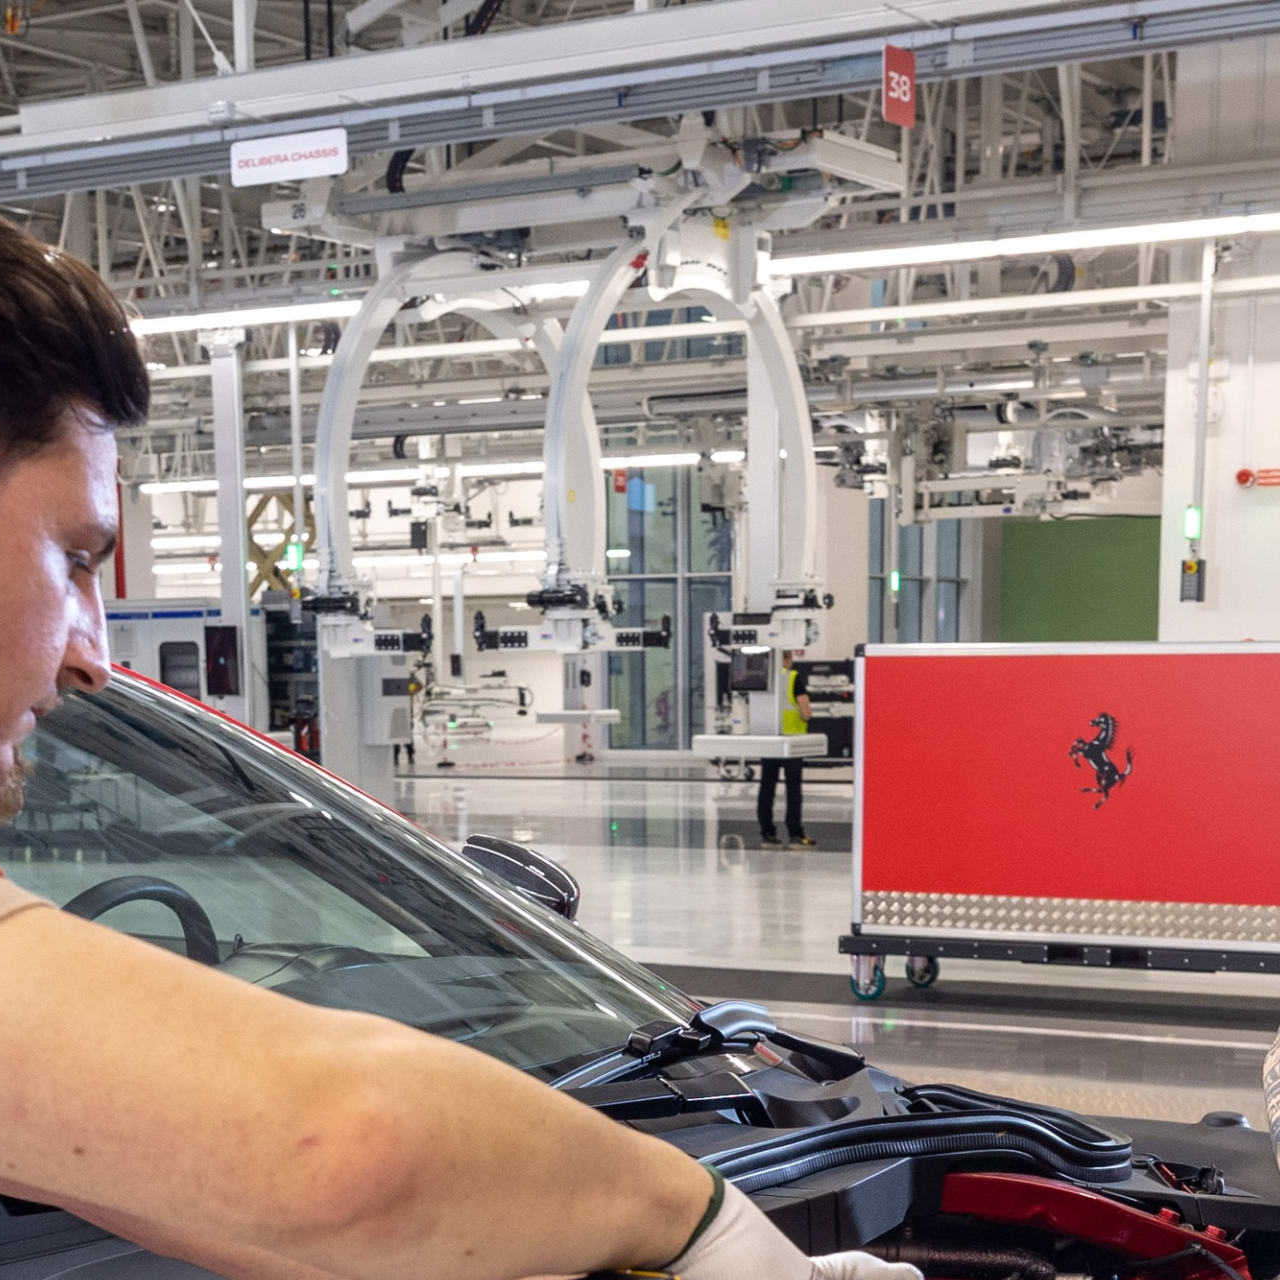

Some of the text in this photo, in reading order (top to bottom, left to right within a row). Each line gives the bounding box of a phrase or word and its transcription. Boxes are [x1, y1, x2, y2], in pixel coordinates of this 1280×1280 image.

[887, 69, 911, 103] 38
[237, 146, 339, 169] DELIBERA CHASSIS
[291, 202, 306, 220] 26
